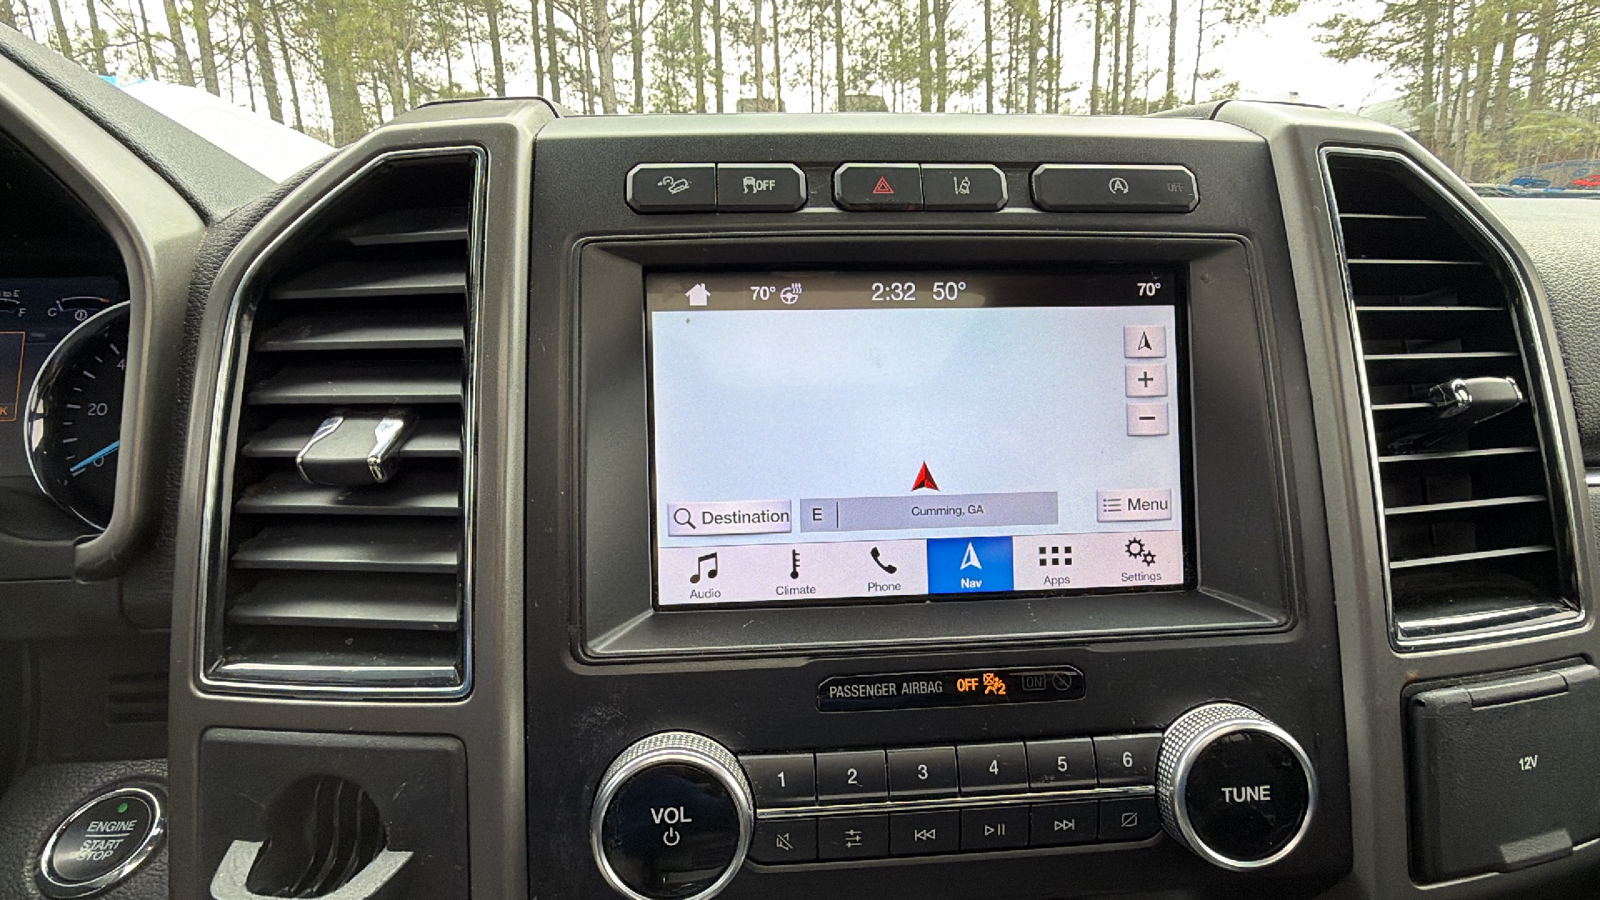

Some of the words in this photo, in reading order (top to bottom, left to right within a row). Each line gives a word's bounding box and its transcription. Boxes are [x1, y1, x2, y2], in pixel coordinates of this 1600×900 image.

[756, 179, 776, 191] OFF
[750, 286, 776, 301] 70°
[871, 282, 916, 301] 2:32
[932, 281, 967, 301] 50°
[1137, 282, 1162, 297] 70°
[18, 307, 27, 317] F
[47, 307, 58, 317] C
[87, 403, 108, 416] 20
[911, 505, 966, 518] Cumming,
[967, 504, 985, 515] GA
[1127, 497, 1168, 512] Menu
[702, 509, 790, 525] Destination
[812, 508, 823, 522] E
[961, 578, 982, 589] Nav
[1043, 575, 1071, 587] Apps
[1120, 571, 1163, 584] Settings
[689, 588, 722, 599] Audio
[775, 584, 817, 596] Climate
[867, 581, 902, 593] Phone
[829, 682, 897, 698] PASSENGER
[901, 681, 943, 695] AIRBAG
[956, 678, 979, 692] OFF
[1026, 676, 1042, 688] ON
[988, 759, 999, 775] 4
[1057, 756, 1068, 772] 5
[1122, 752, 1133, 768] 6
[1518, 755, 1538, 771] 12V
[777, 771, 786, 787] 1
[847, 769, 859, 784] 2
[917, 764, 929, 780] 3
[1221, 785, 1271, 803] TUNE
[650, 807, 692, 824] VOL
[86, 820, 138, 833] ENGINE
[80, 838, 124, 851] START
[76, 850, 114, 861] STOP
